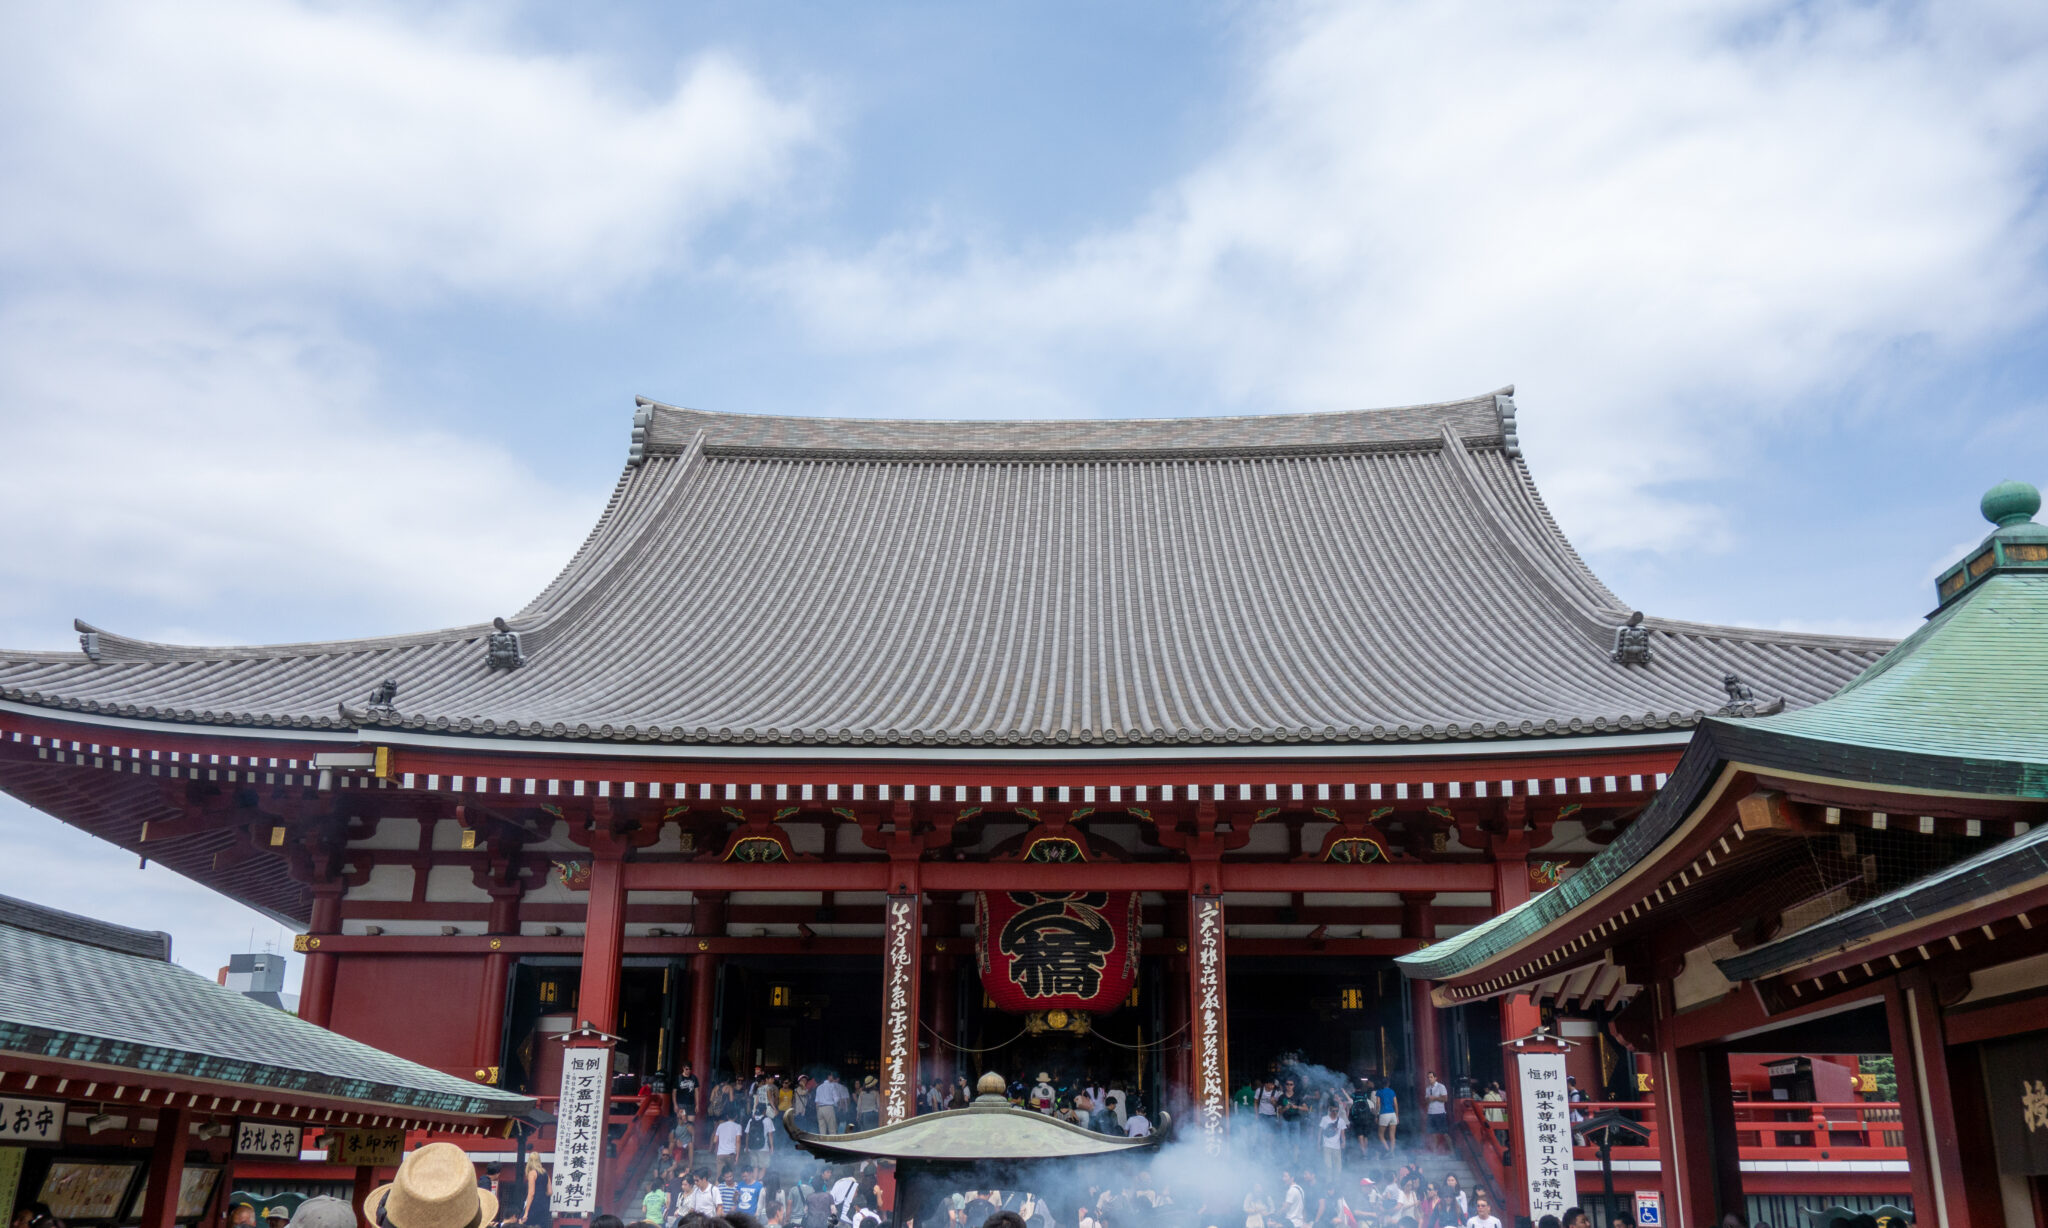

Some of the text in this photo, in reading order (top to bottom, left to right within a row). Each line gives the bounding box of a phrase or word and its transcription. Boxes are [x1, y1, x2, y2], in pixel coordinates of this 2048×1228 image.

[571, 1057, 600, 1071] 恒例
[1528, 1068, 1558, 1080] 恒例
[240, 1126, 295, 1154] お札お守
[348, 1134, 400, 1153] 朱印所
